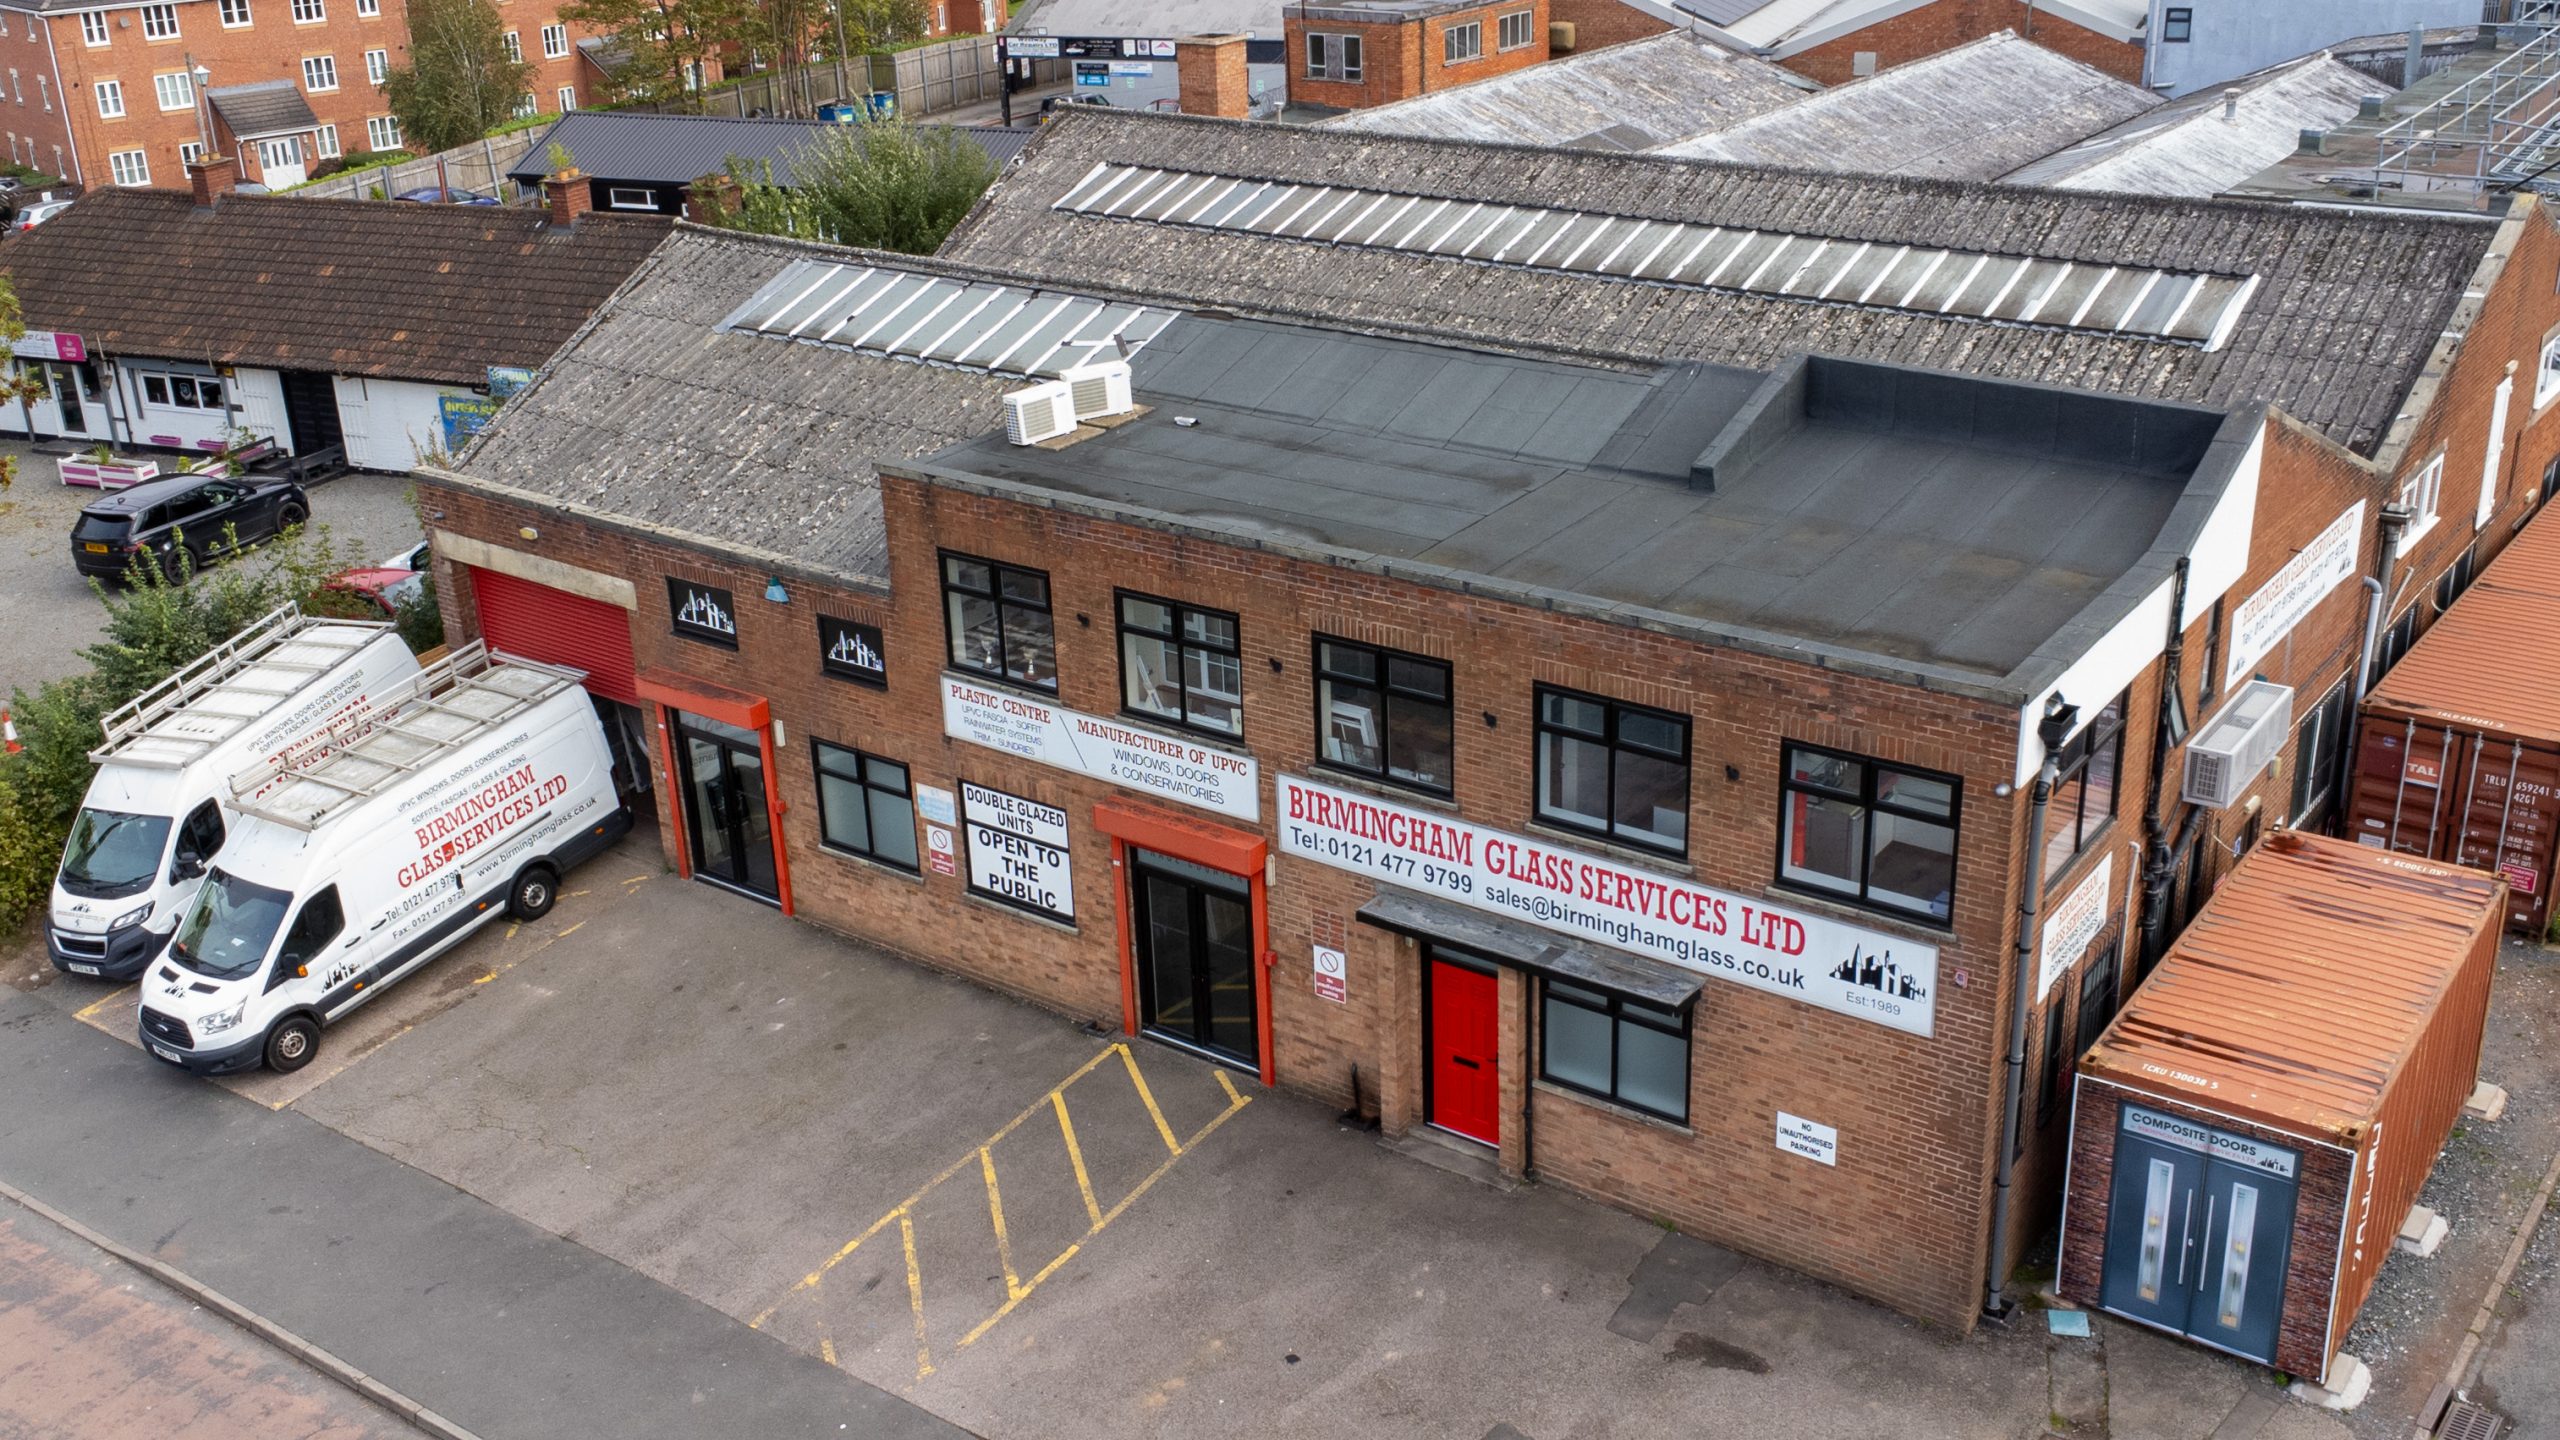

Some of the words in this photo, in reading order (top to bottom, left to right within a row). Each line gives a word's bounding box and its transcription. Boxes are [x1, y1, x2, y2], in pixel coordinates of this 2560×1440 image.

[285, 715, 310, 736] FASCIAS
[312, 702, 332, 721] GLASS
[337, 680, 362, 700] GLAZING
[294, 702, 316, 720] DOORS
[315, 668, 364, 704] CONSERVATORIES
[951, 684, 998, 709] PLASTIC
[1002, 699, 1051, 724] CENTRE
[961, 704, 981, 718] UPVC
[982, 709, 1008, 726] FASCIA
[1016, 718, 1042, 734] SOFFIT
[963, 717, 1007, 737] RAINWATER
[1007, 728, 1043, 747] SYSTEMS
[451, 764, 474, 782] DOORS
[474, 732, 530, 769] CONSERVATORIES
[973, 730, 991, 743] TRIM
[998, 736, 1036, 756] SUNDRIES
[1077, 718, 1184, 760] MANUFACTURER
[1189, 749, 1207, 765] OF
[1211, 755, 1247, 776] UPVC
[440, 785, 469, 810] FASCIAS
[471, 773, 494, 791] GLASS
[499, 753, 528, 774] GLAZING
[1110, 763, 1119, 775] &
[1121, 766, 1225, 805] CONSERVATORIES
[1112, 748, 1174, 776] WINDOWS,
[1176, 765, 1219, 787] DOORS
[2407, 763, 2437, 777] TAL
[2484, 773, 2507, 787] TRLU
[2515, 781, 2550, 797] 659241
[414, 763, 537, 850] BIRMINGHAM
[453, 794, 535, 857] SERVICES
[537, 774, 568, 807] LTD
[966, 786, 1014, 813] DOUBLE
[1017, 802, 1064, 828] GLAZED
[2513, 793, 2536, 805] 42G1
[997, 811, 1034, 835] UNITS
[978, 829, 1029, 859] OPEN
[1035, 845, 1060, 868] TO
[1001, 856, 1039, 883] THE
[1288, 784, 1473, 867] BIRMINGHAM
[1484, 838, 1573, 895] GLASS
[1580, 864, 1728, 937] SERVICES
[1741, 906, 1807, 956] LTD
[385, 905, 402, 921] Tel:
[402, 892, 423, 912] 0121
[424, 881, 439, 898] 477
[411, 911, 431, 928] 0121
[432, 900, 446, 914] 477
[447, 888, 466, 905] 9729
[989, 873, 1057, 909] PUBLIC
[1328, 837, 1374, 866] 0121
[1380, 852, 1416, 878] 477
[1423, 863, 1473, 894] 9799
[1486, 884, 1805, 990] sales@birminghamglass.co.uk
[2142, 1063, 2168, 1076] TCKU
[2169, 1070, 2208, 1087] 130038
[1779, 1126, 1834, 1150] UNAUTHORISED
[1801, 1123, 1812, 1132] NO
[2131, 1112, 2206, 1142] COMPOSITE
[2210, 1135, 2257, 1157] DOORS
[1790, 1140, 1821, 1157] PARKING
